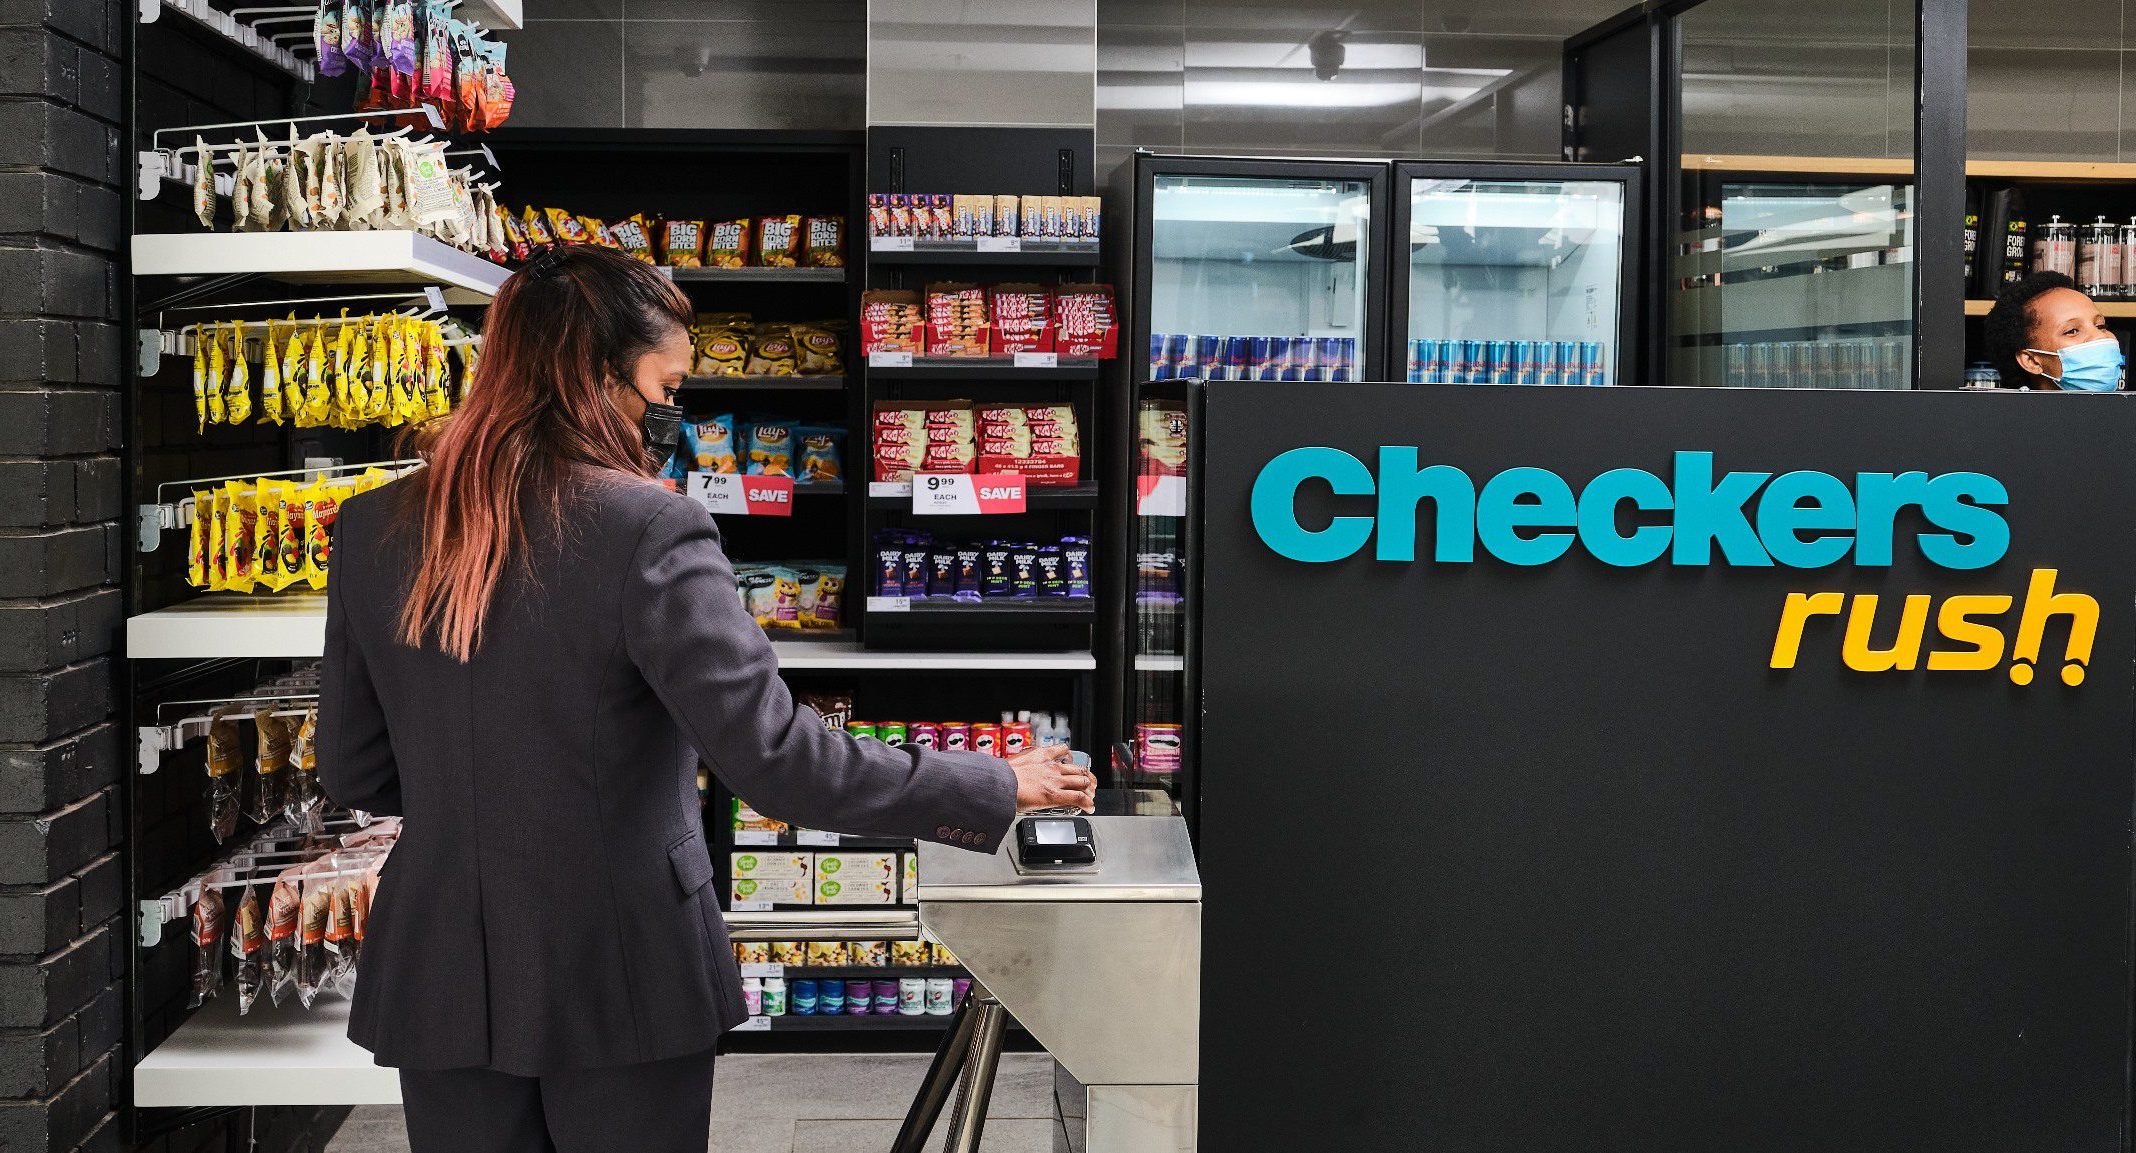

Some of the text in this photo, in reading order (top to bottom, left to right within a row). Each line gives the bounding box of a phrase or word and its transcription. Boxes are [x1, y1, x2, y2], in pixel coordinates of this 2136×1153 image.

[670, 224, 698, 236] BIG
[715, 224, 741, 235] BIG
[764, 222, 792, 236] BIG
[811, 221, 838, 232] BIG
[810, 239, 837, 247] BITES
[749, 489, 788, 502] SAVE
[980, 487, 1021, 500] SAVE
[1251, 446, 2010, 569] Checkers
[1770, 569, 2100, 686] rush
